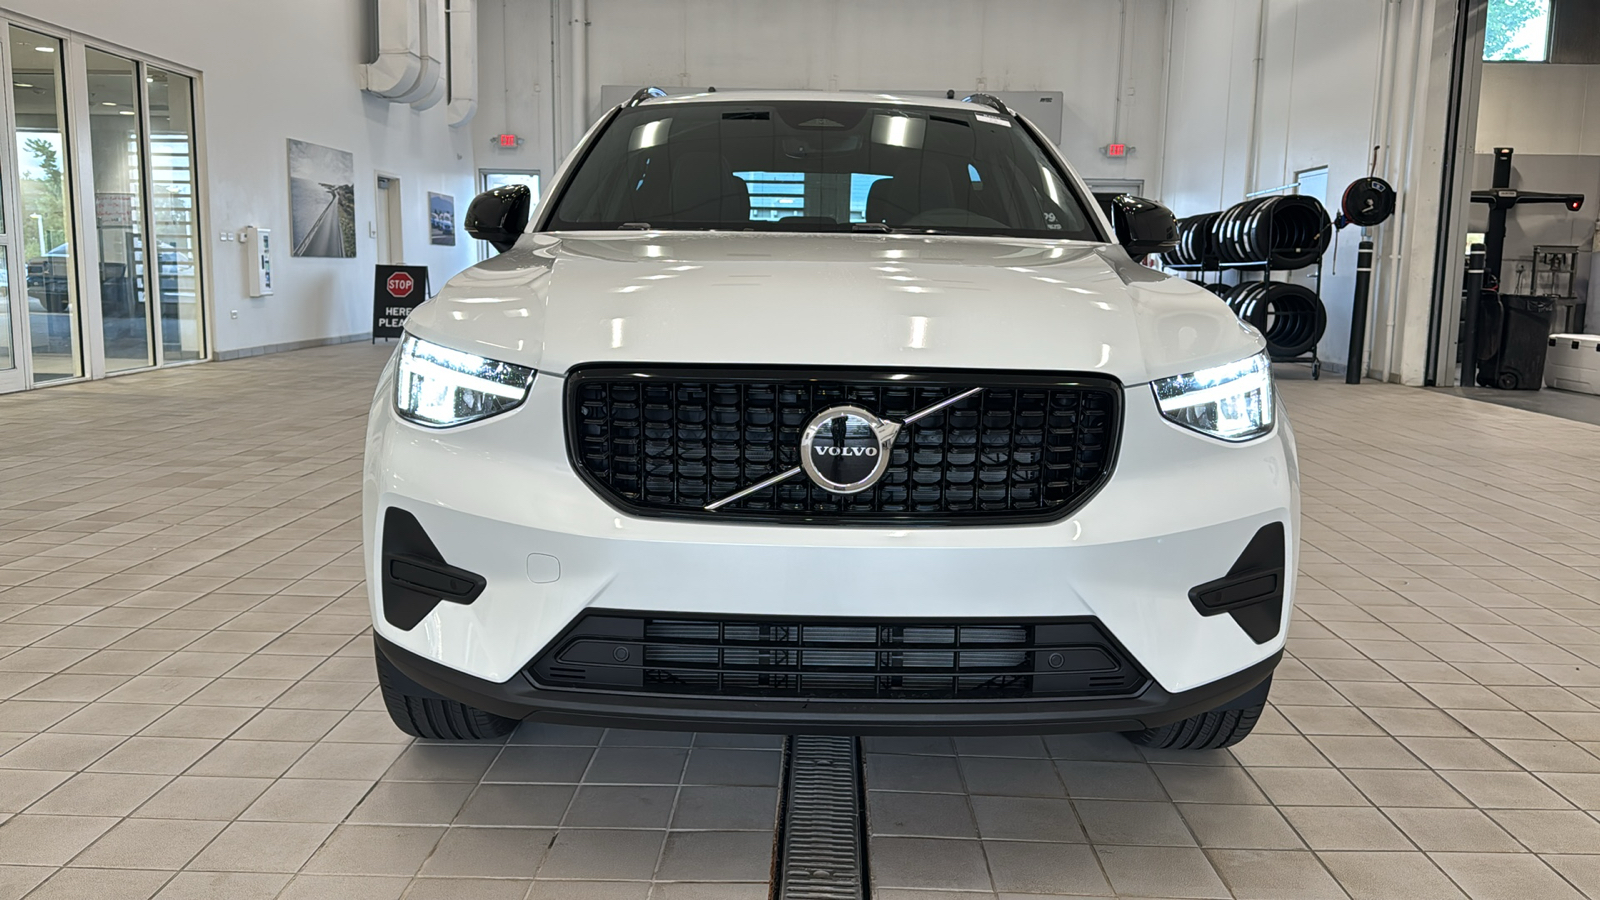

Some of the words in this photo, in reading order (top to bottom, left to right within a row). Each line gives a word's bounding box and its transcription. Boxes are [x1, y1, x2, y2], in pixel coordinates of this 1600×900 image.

[388, 279, 412, 290] STOP
[385, 306, 412, 316] HERE
[378, 318, 405, 328] PLEA
[814, 445, 878, 457] VOLVO
